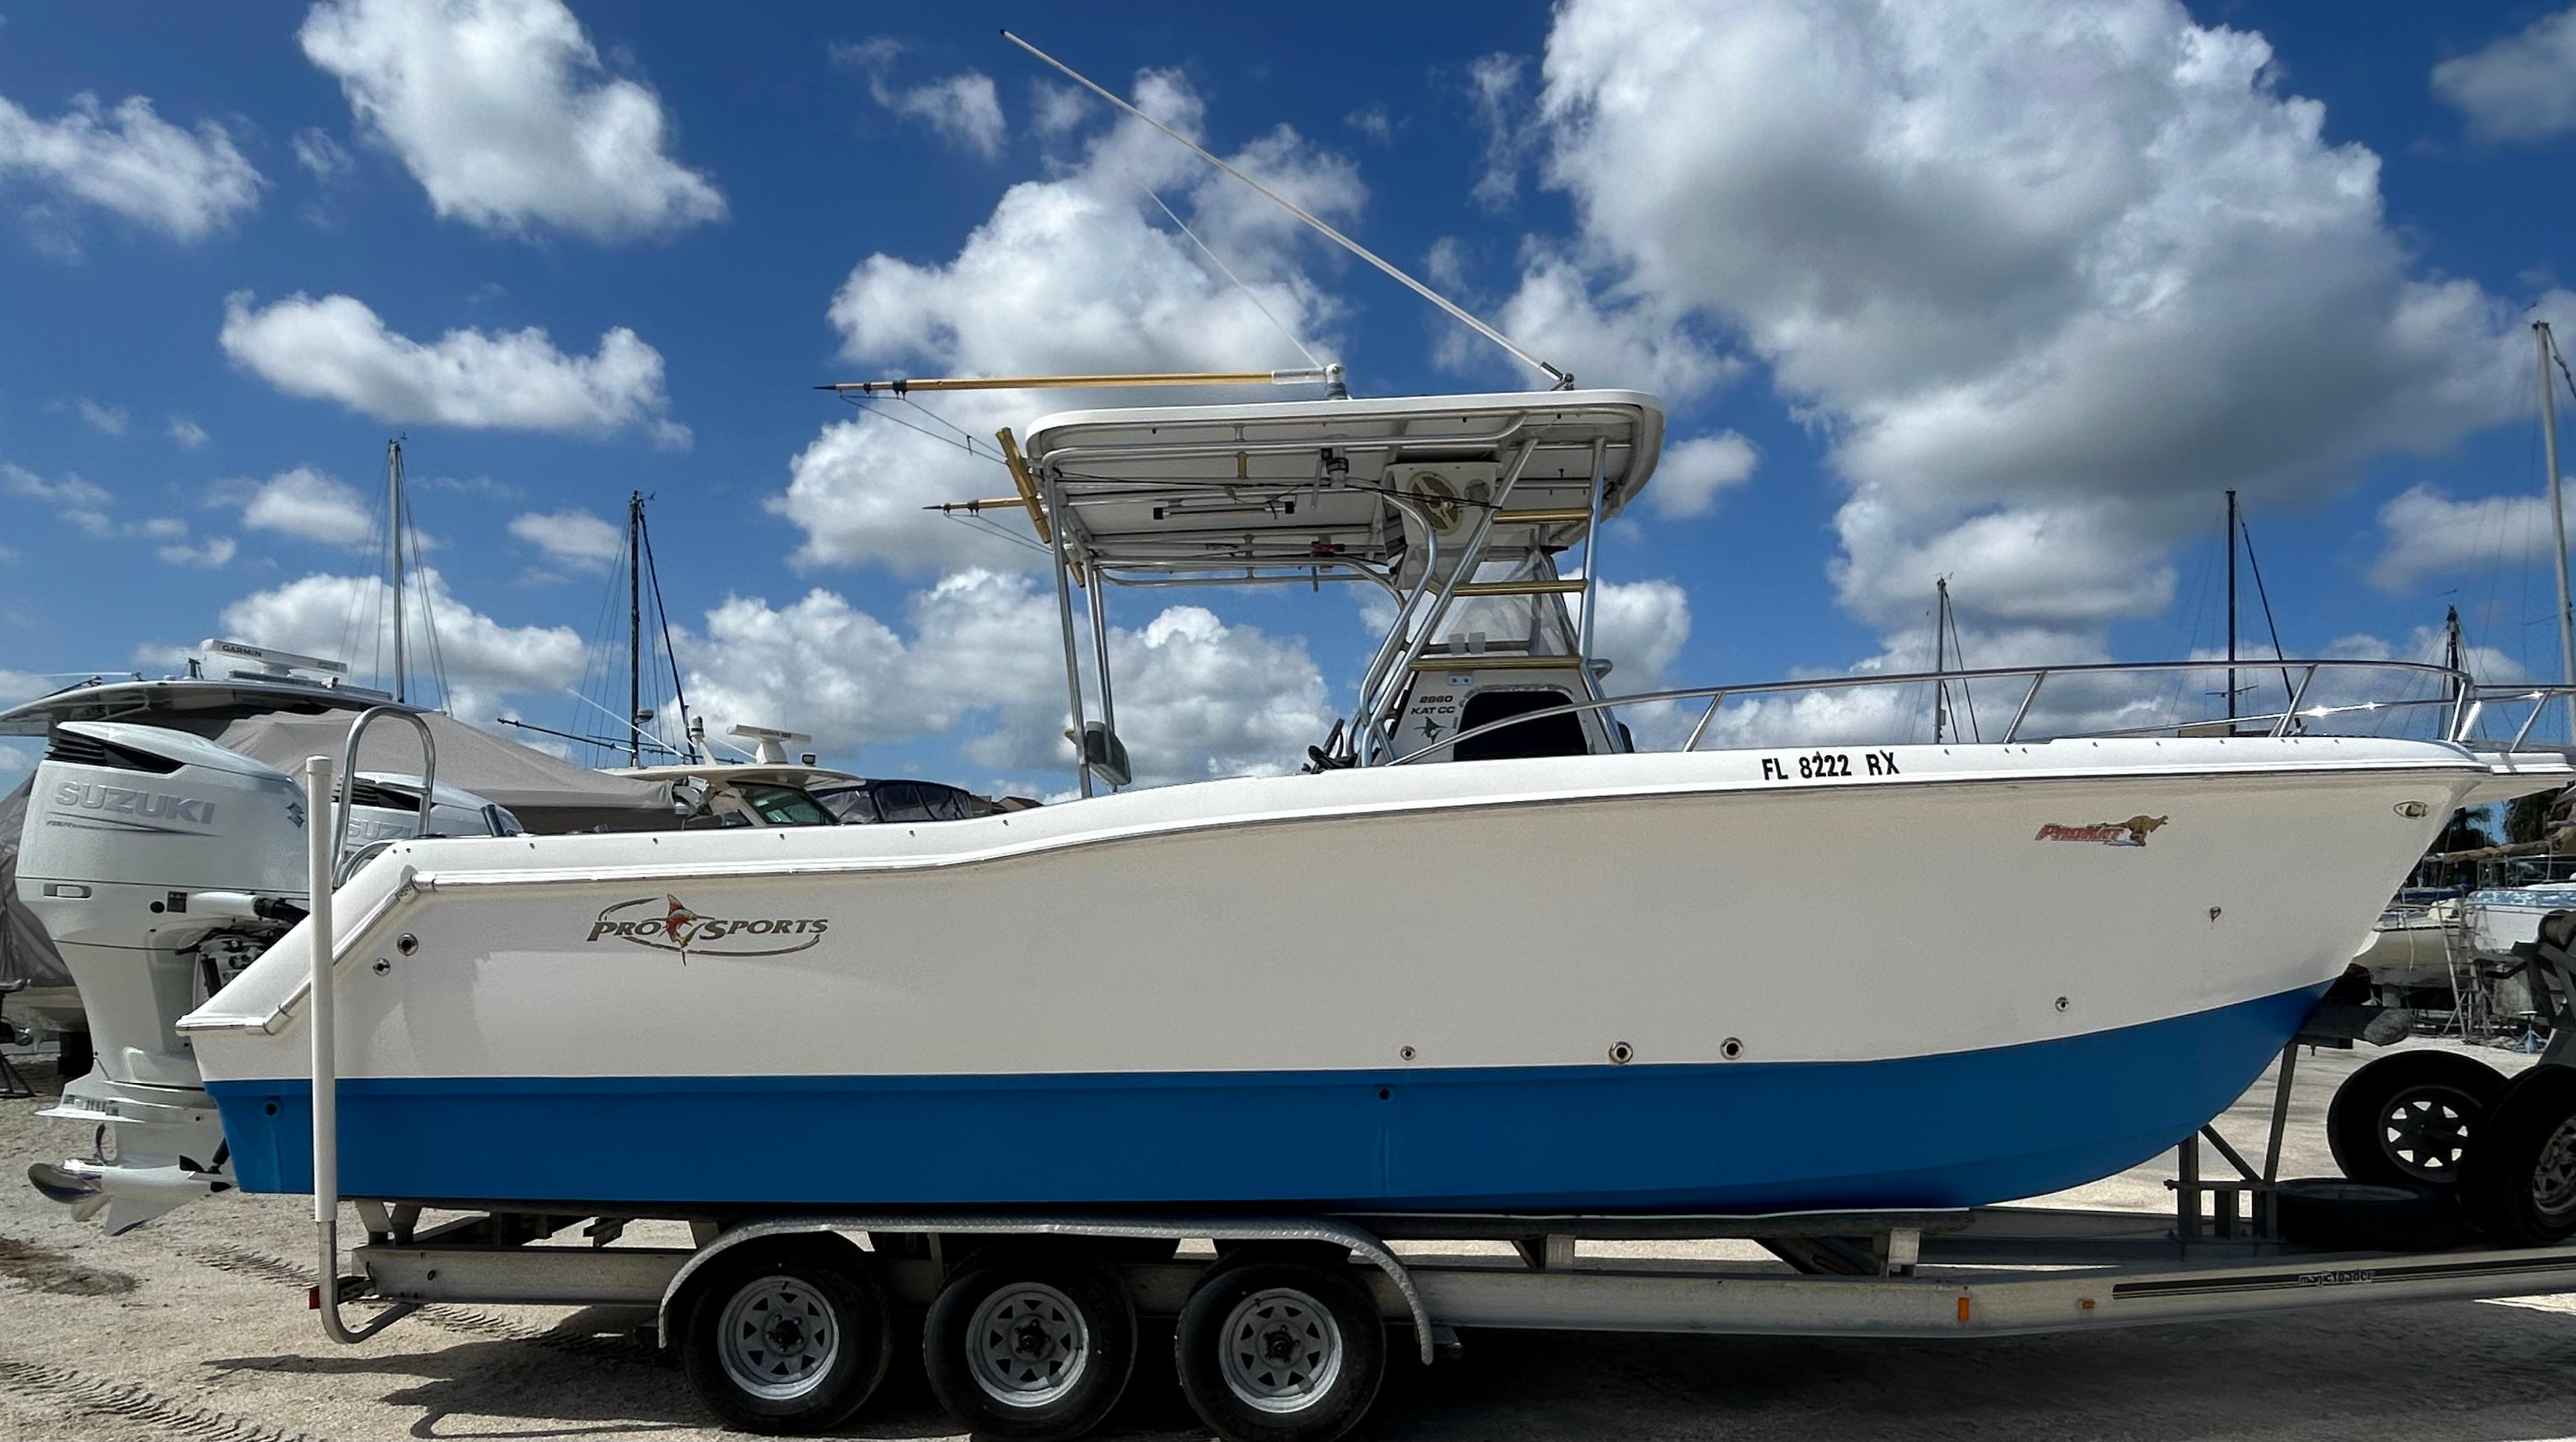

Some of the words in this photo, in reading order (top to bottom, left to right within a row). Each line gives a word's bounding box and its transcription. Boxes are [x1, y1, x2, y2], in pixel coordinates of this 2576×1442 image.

[222, 644, 262, 657] GARMIN
[1762, 758, 1788, 780] FL
[1798, 754, 1852, 779] 8222
[1865, 751, 1900, 776] RX
[55, 780, 216, 825] SUZUKI
[586, 921, 663, 941] PRO
[699, 919, 829, 939] SPORTS
